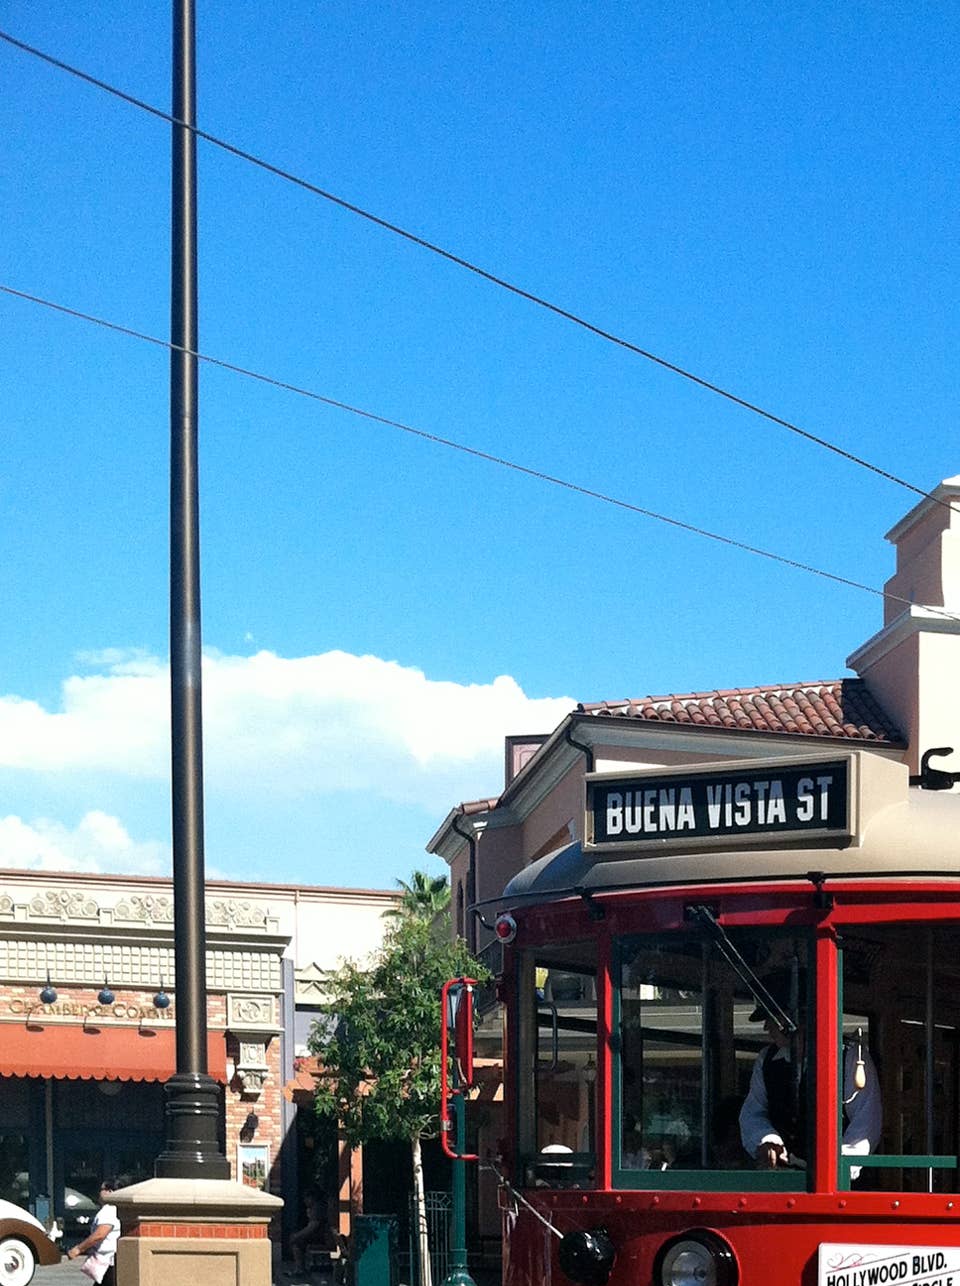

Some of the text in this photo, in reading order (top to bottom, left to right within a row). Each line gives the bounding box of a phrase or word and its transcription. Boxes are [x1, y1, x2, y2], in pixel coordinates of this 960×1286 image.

[606, 775, 833, 836] BUENA VISTA ST
[8, 999, 90, 1017] CHAMBER
[112, 1003, 174, 1020] COMME
[912, 1252, 948, 1277] BLVD.
